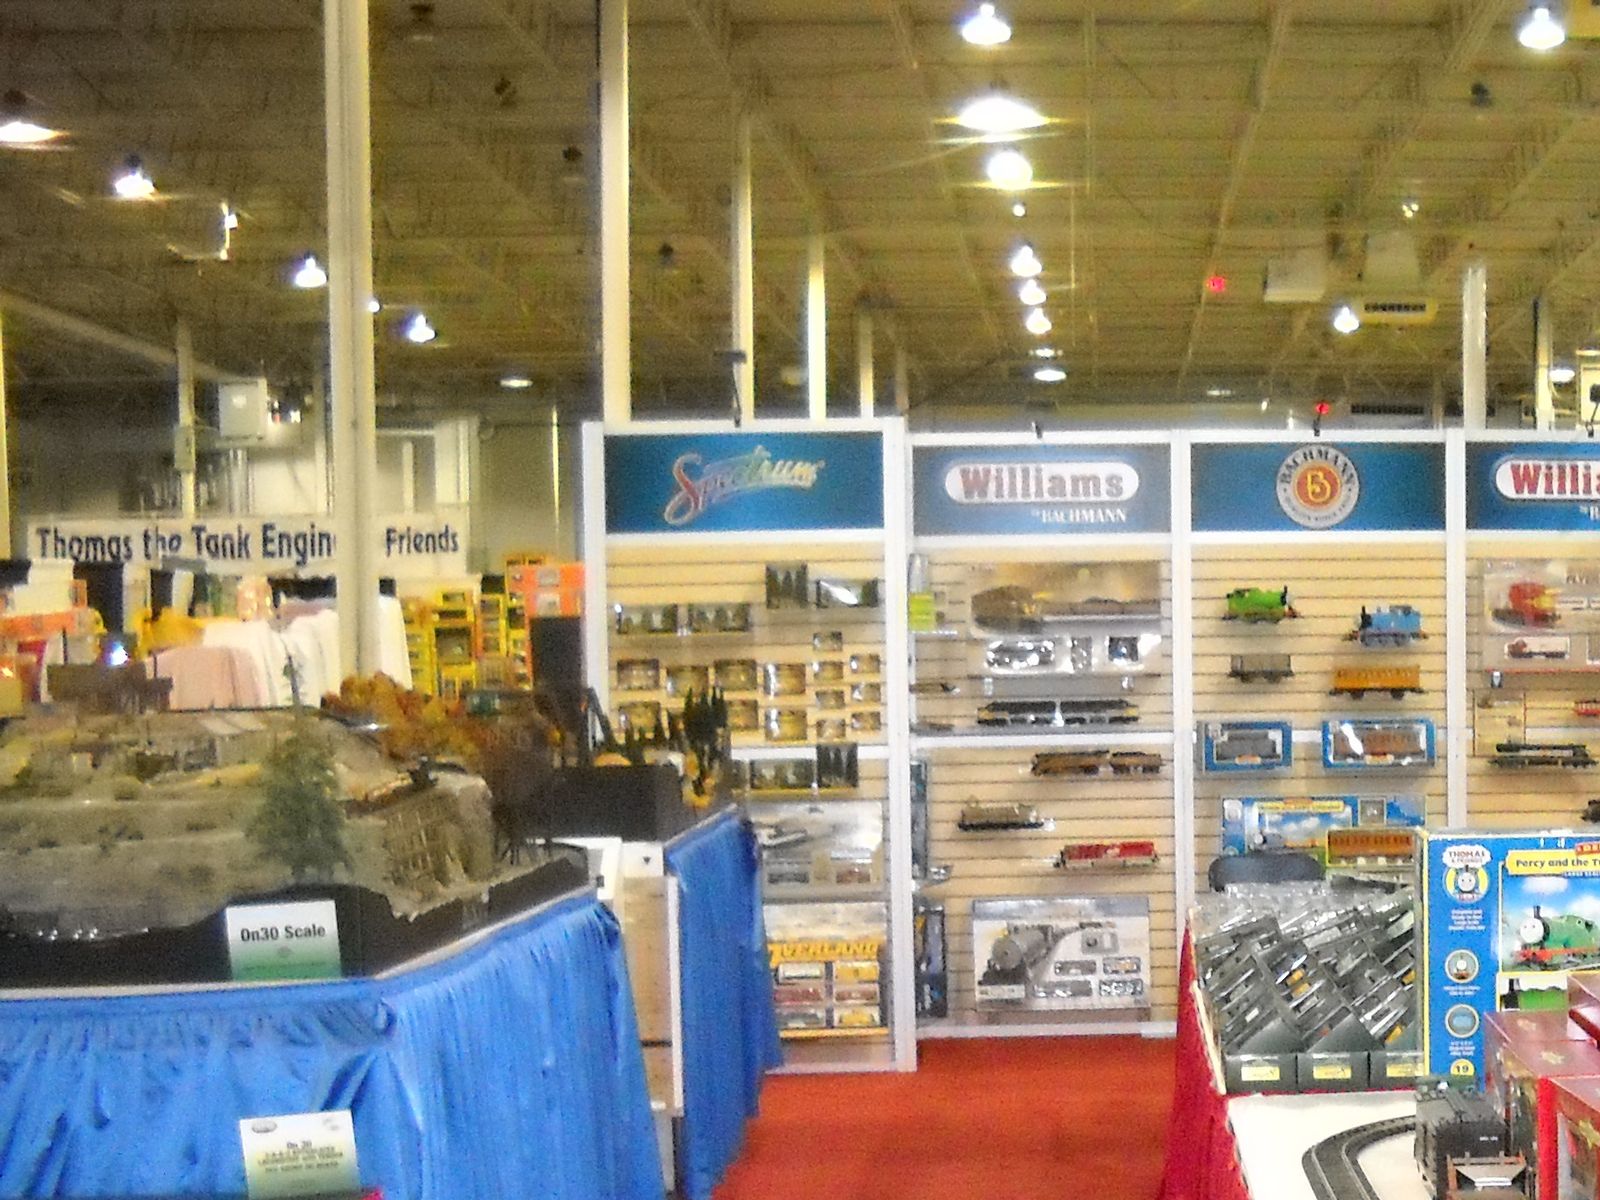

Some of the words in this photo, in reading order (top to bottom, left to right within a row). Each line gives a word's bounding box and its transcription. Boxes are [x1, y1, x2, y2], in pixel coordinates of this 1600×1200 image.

[959, 465, 1124, 500] Williams
[1041, 507, 1127, 524] BACHMANN
[37, 525, 133, 563] Thomas
[143, 524, 182, 561] the
[191, 522, 251, 561] Tank
[262, 521, 337, 567] Engin
[386, 524, 459, 557] Friends
[1515, 858, 1546, 870] Percy
[1548, 857, 1569, 868] and
[1571, 857, 1590, 867] the
[241, 929, 279, 942] On30
[285, 924, 326, 940] Scale
